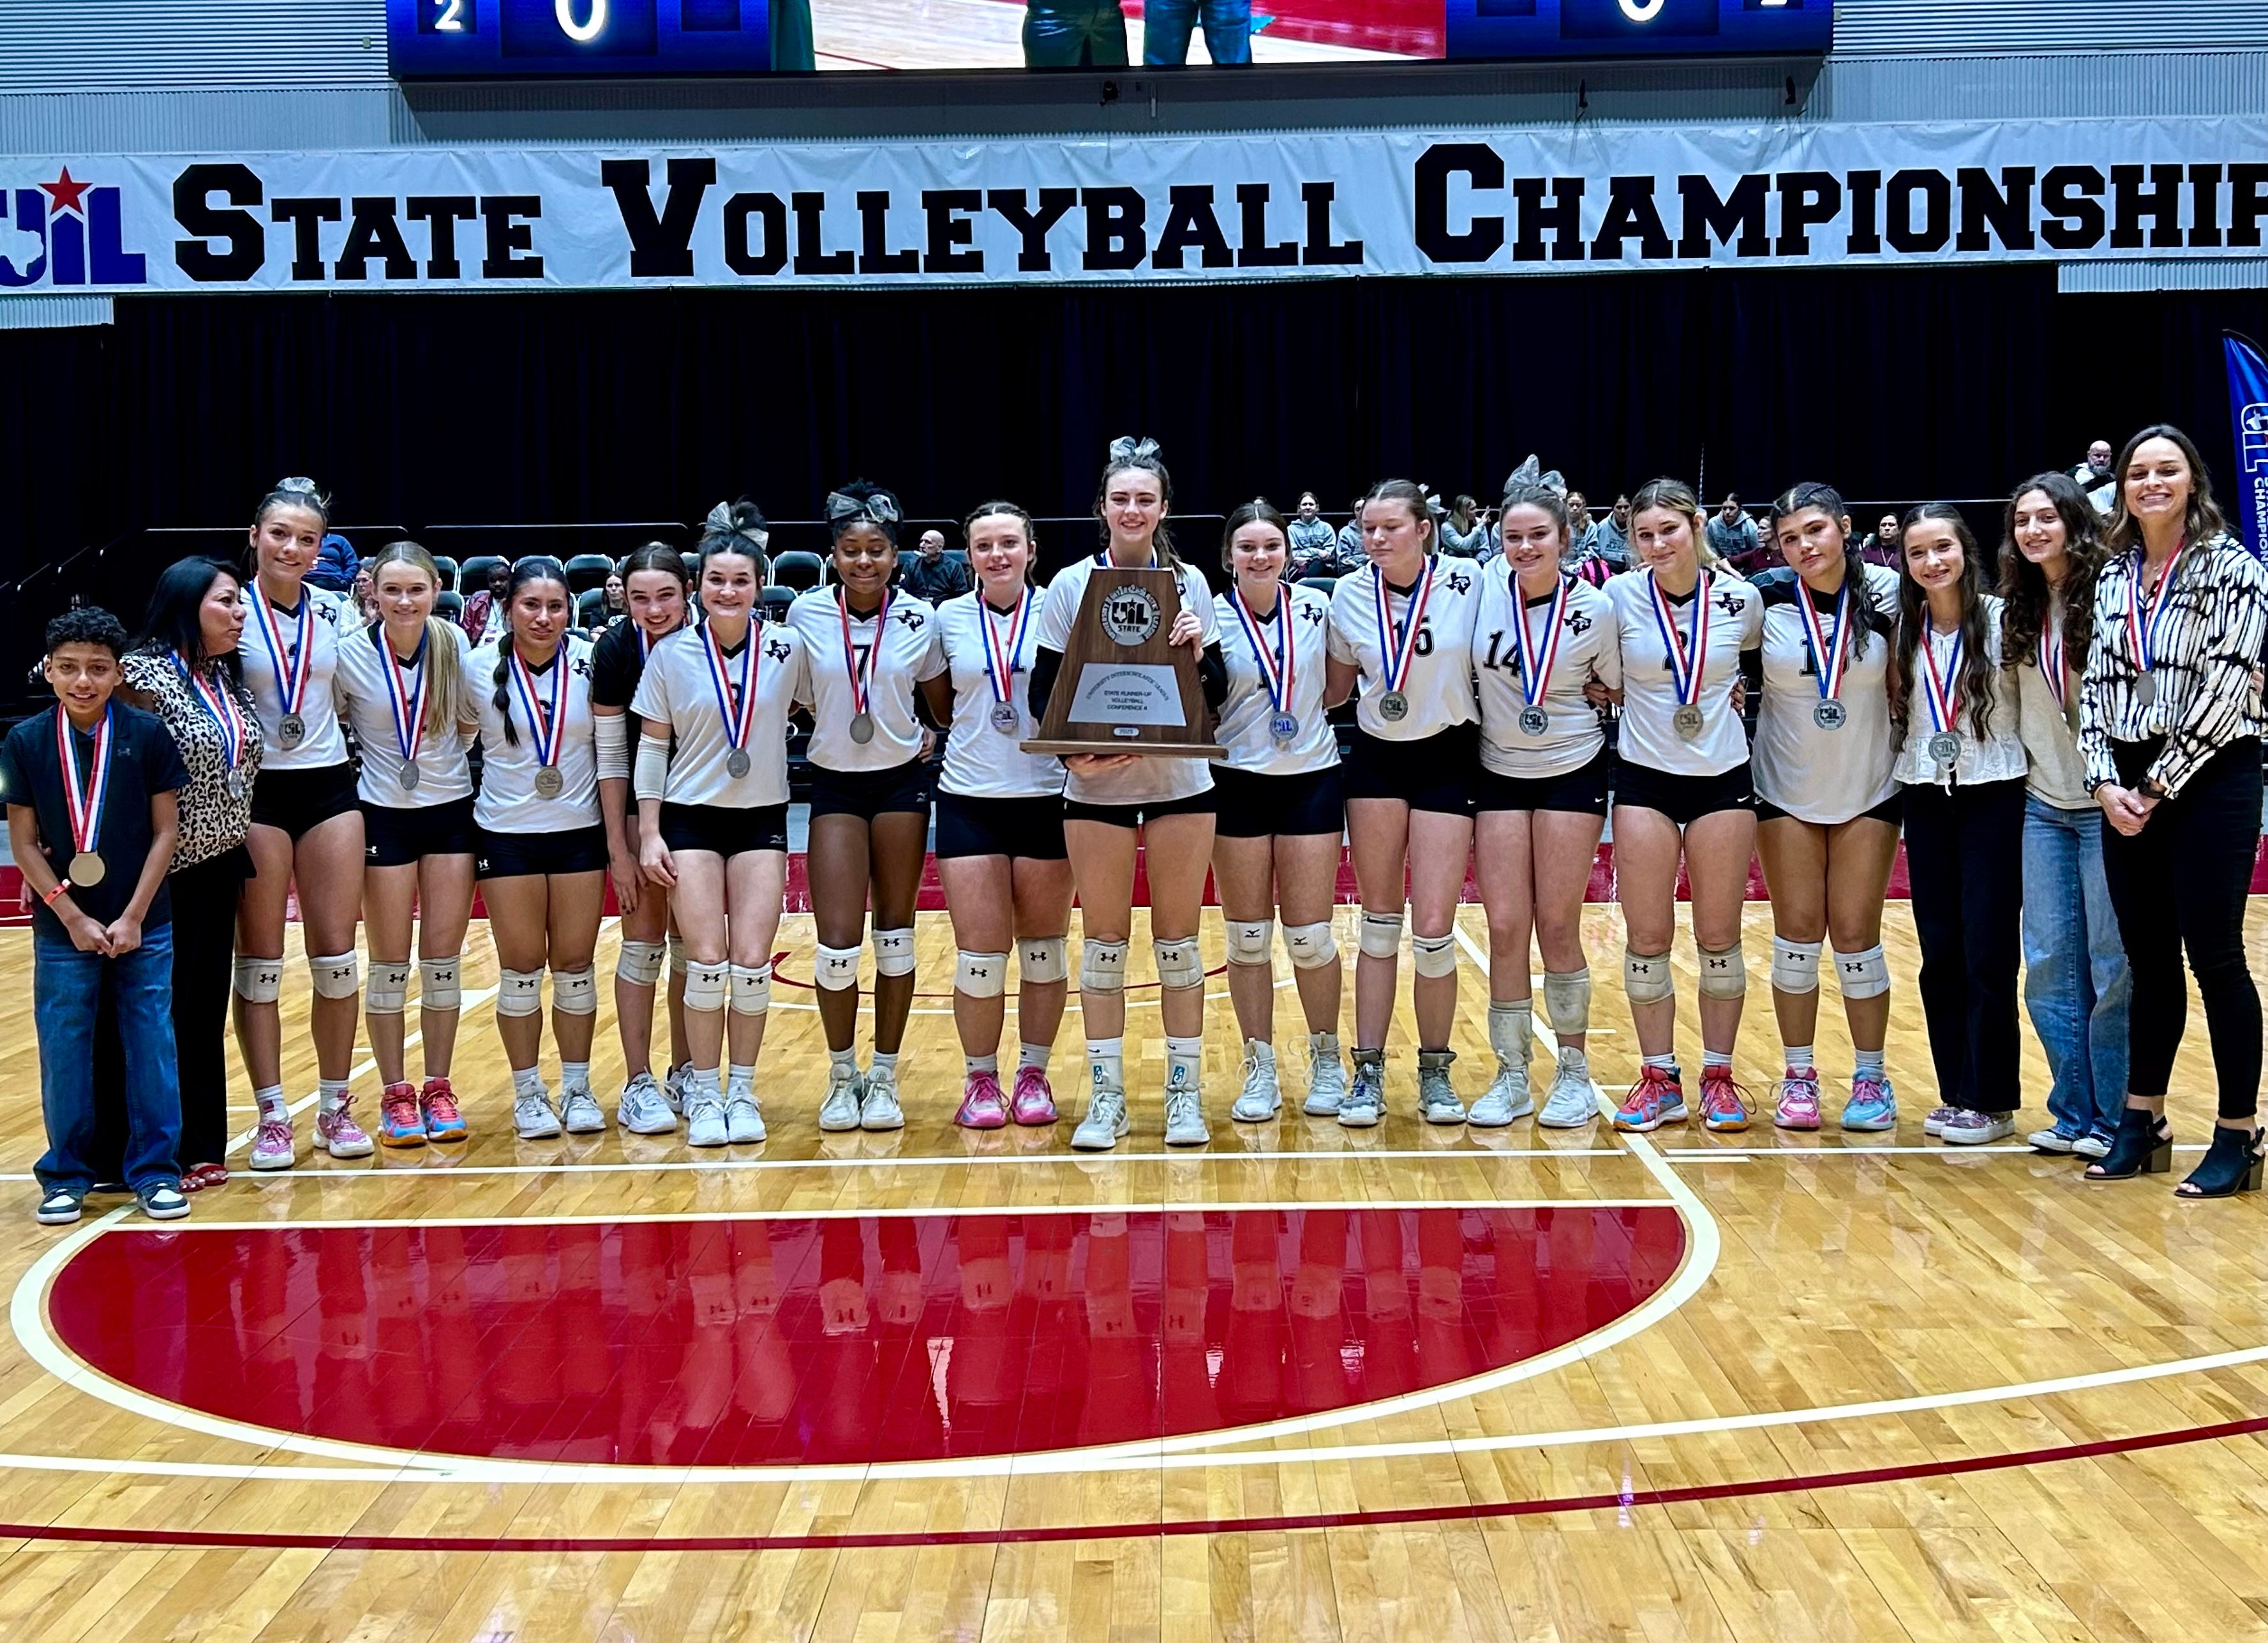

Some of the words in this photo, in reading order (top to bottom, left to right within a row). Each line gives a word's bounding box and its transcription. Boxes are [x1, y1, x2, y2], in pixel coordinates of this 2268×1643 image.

[173, 164, 544, 281] STATE
[601, 157, 1364, 277] VOLLEYBALL
[851, 643, 872, 684] 7
